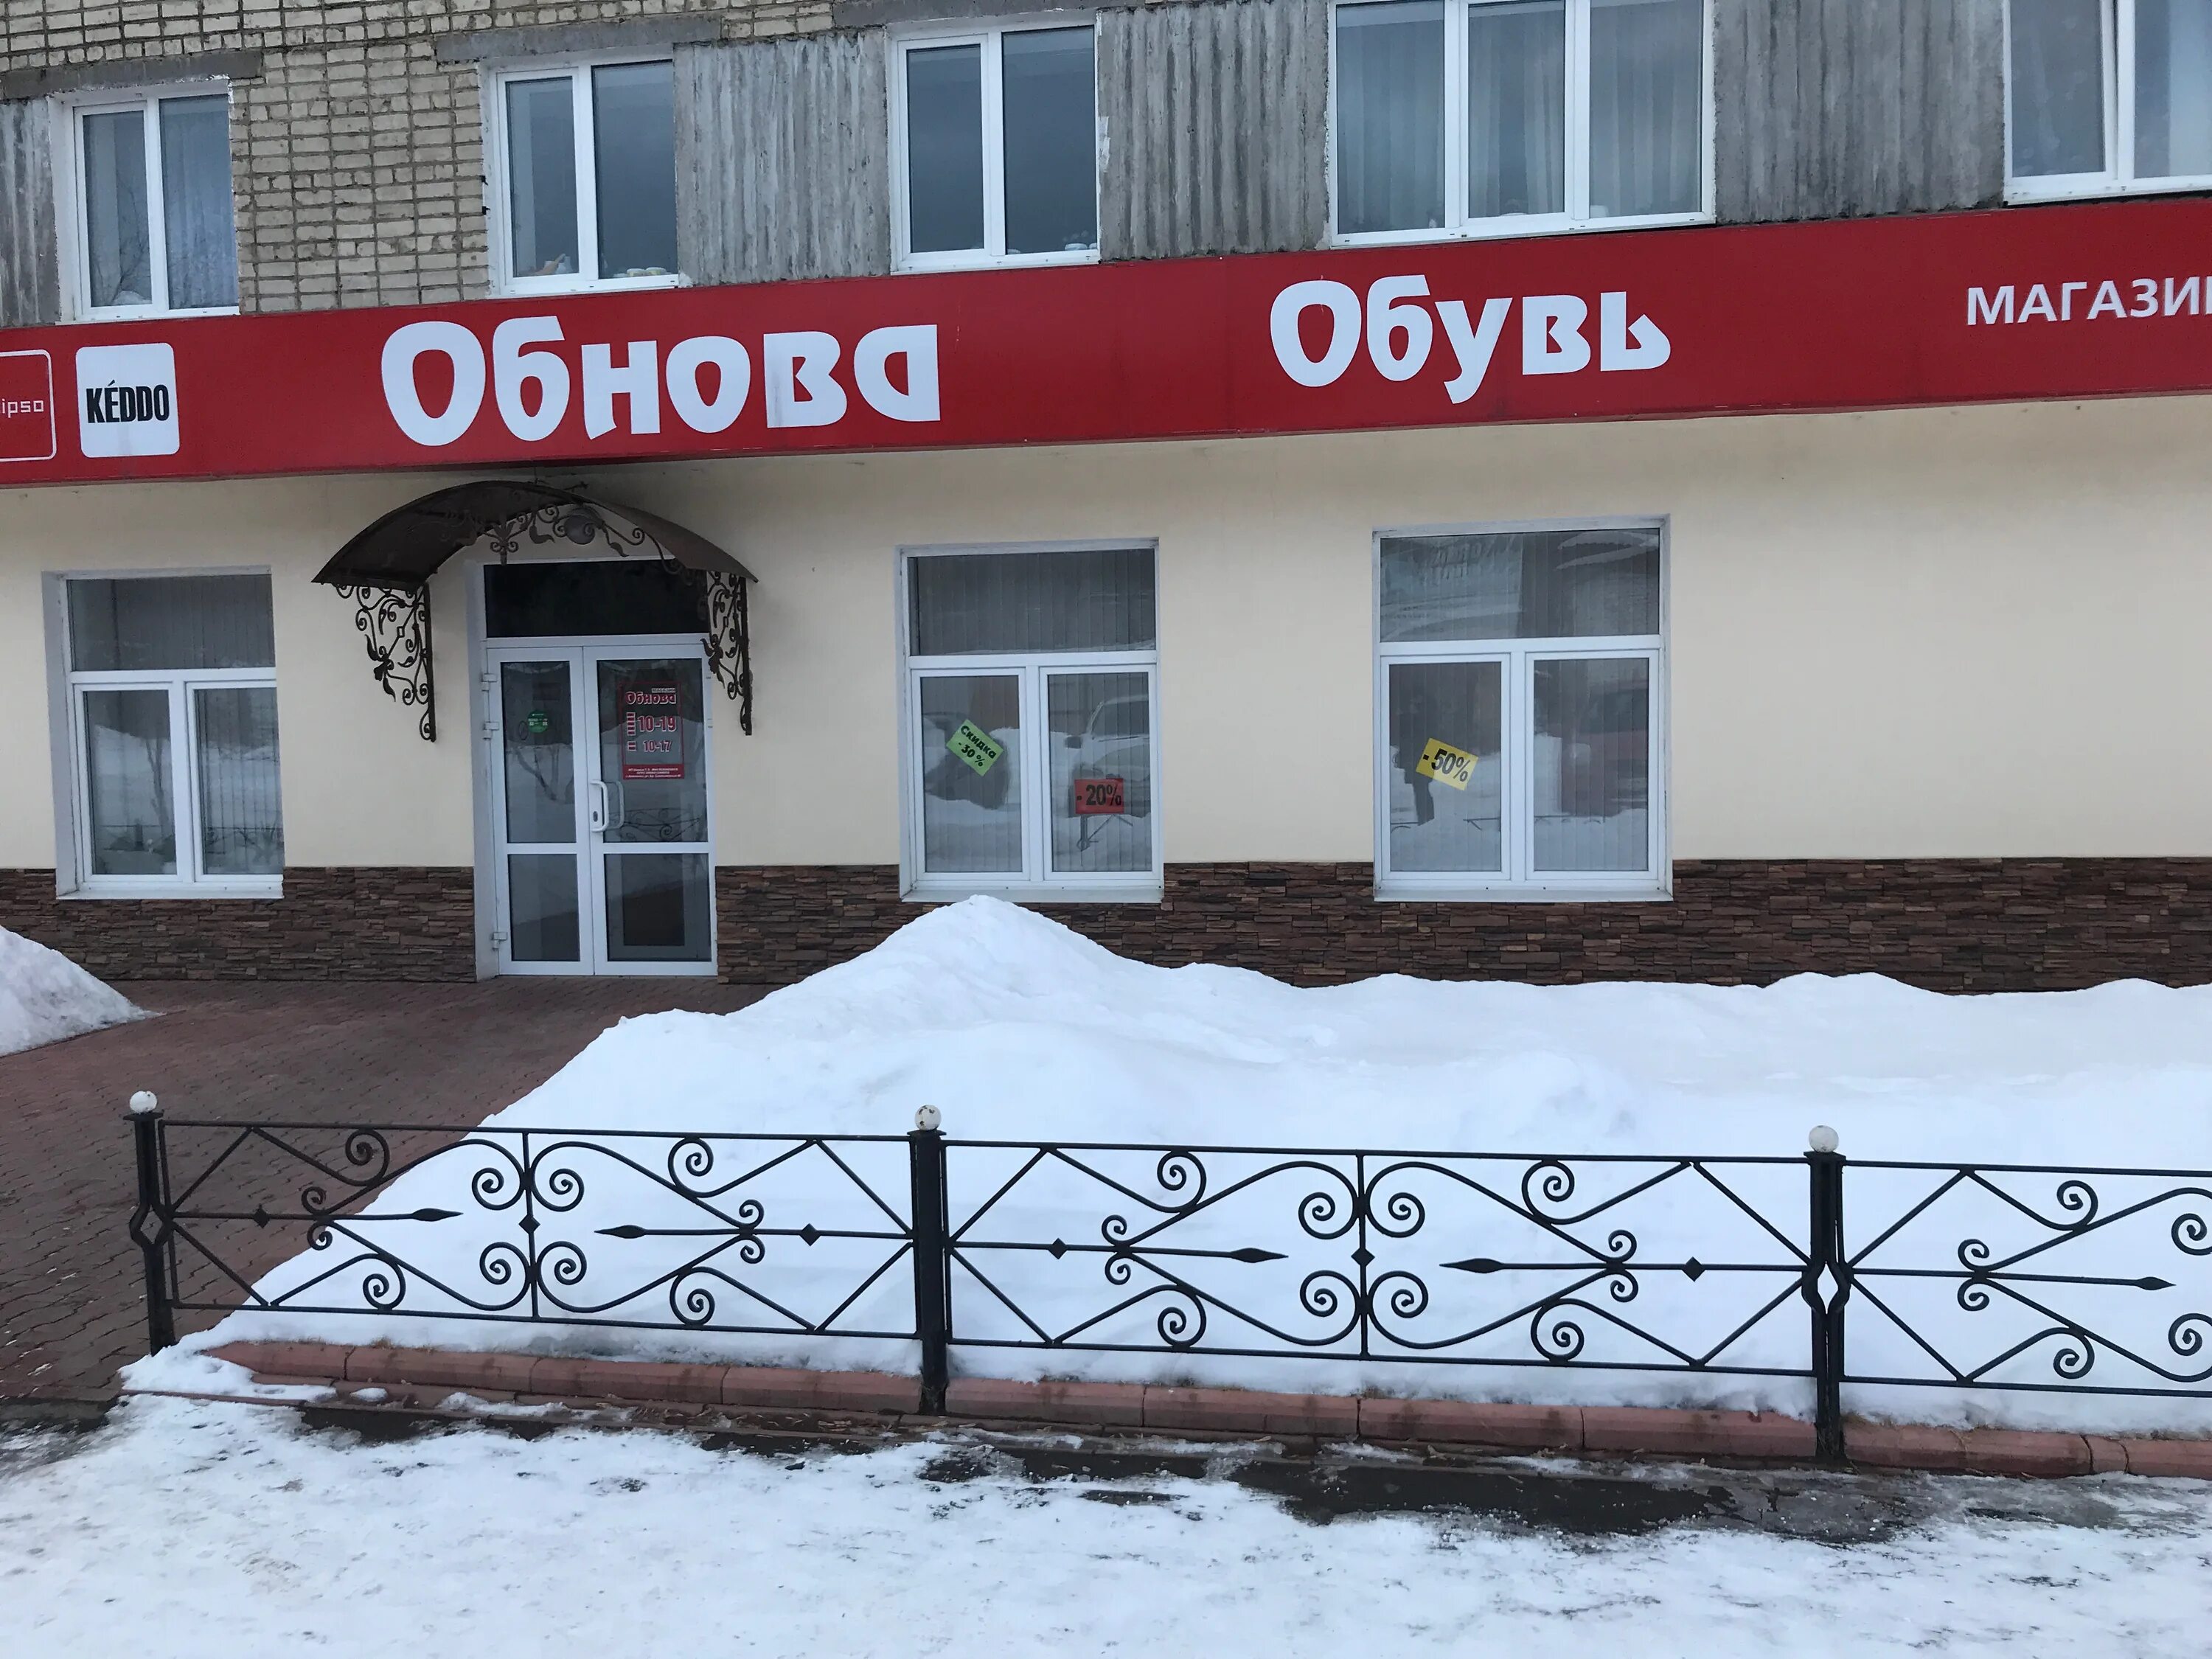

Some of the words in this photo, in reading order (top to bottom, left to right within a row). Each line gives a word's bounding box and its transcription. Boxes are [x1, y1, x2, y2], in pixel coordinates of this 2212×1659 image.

[1967, 276, 2212, 326] МАГАЗИ
[1270, 274, 1671, 404] Обувь
[380, 315, 941, 446] Обнова
[86, 380, 170, 424] KÉDDO
[625, 691, 677, 705] Обнова
[637, 715, 677, 732] 10-19
[960, 725, 997, 759] Скидка
[643, 740, 672, 752] 10-17
